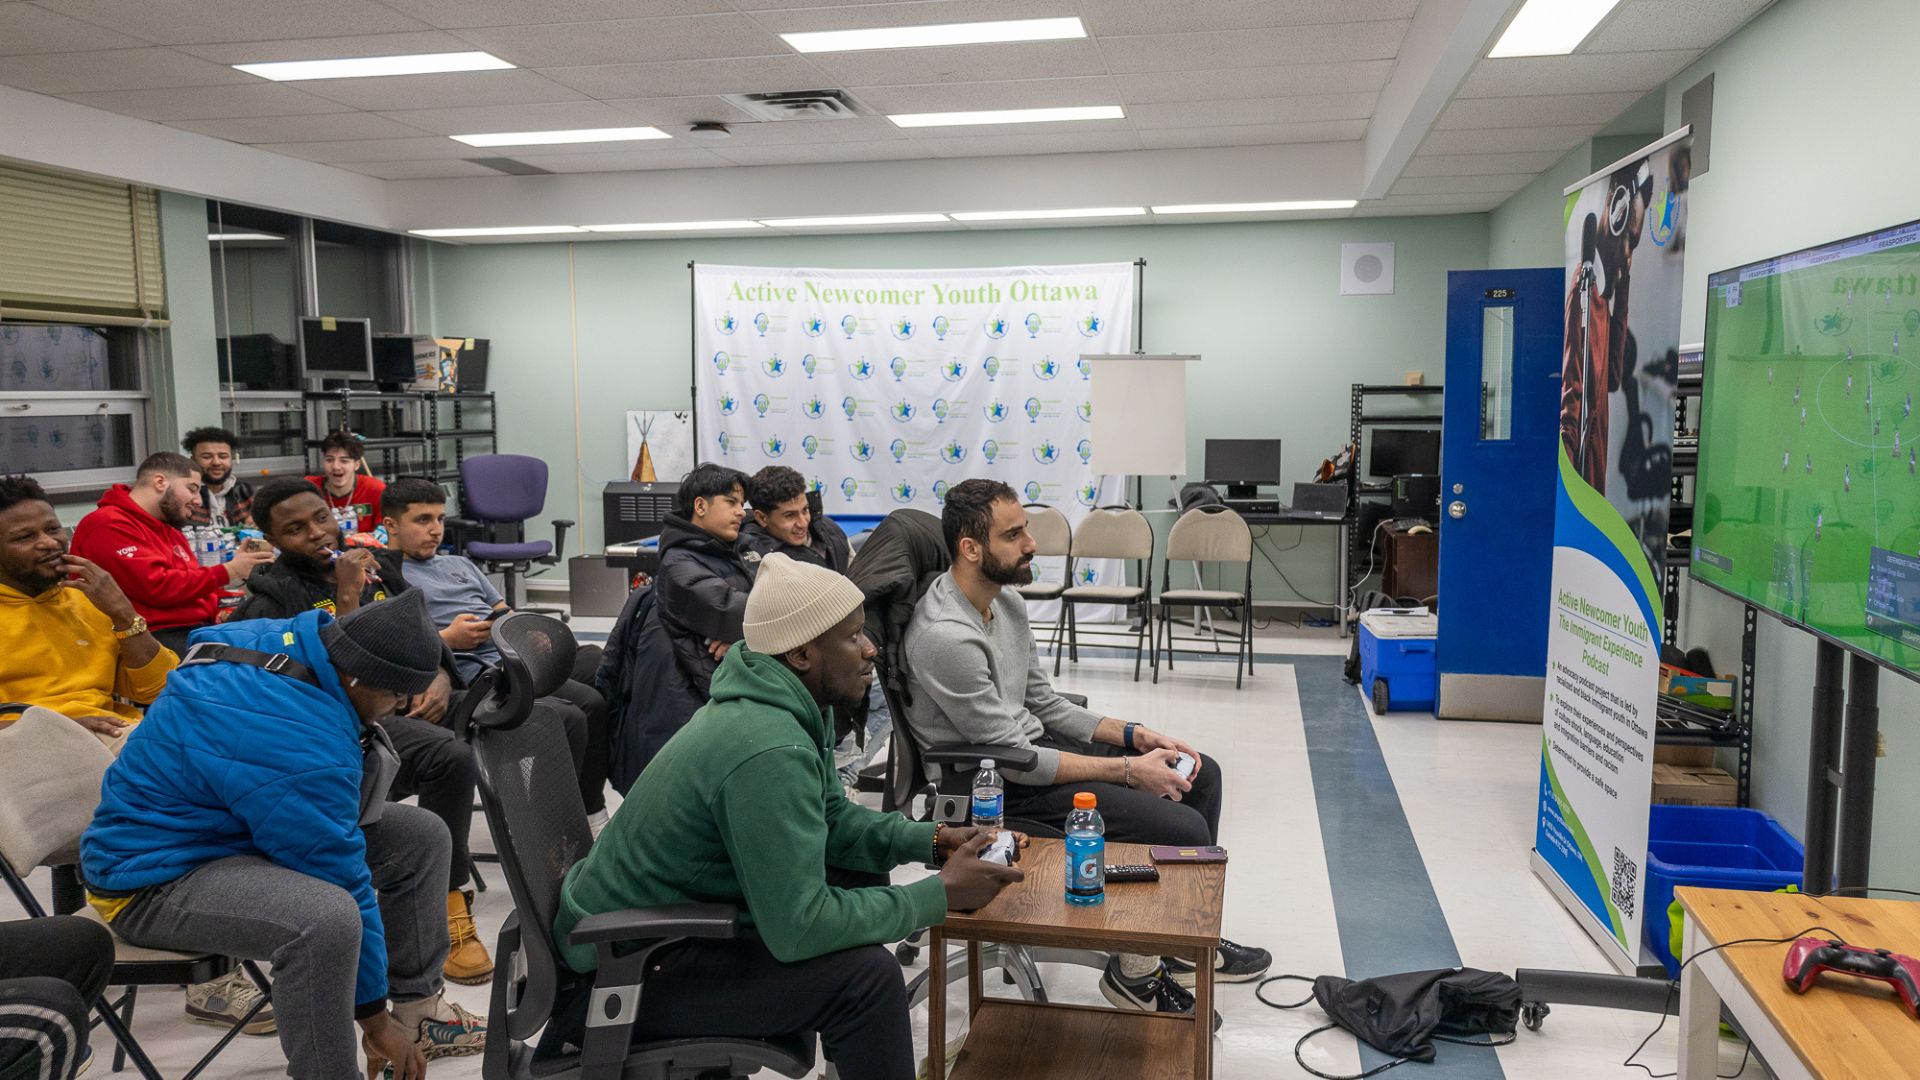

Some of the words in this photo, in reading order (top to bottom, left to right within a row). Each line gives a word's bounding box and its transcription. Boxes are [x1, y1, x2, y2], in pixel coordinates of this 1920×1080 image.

[728, 280, 797, 302] Active
[804, 281, 926, 305] Newcomer
[932, 282, 1000, 305] Youth
[1010, 280, 1098, 302] Ottawa
[1493, 289, 1507, 298] 225
[1558, 588, 1578, 610] Active
[1580, 597, 1621, 630] Newcomer
[1624, 614, 1648, 642] Youth
[1560, 614, 1569, 631] The
[1570, 621, 1602, 648] Immigrant
[1603, 634, 1644, 668] Experience
[1582, 650, 1610, 676] Podcast
[1557, 661, 1562, 671] An
[1563, 666, 1579, 682] advocacy
[1579, 676, 1595, 691] podcast
[1595, 684, 1610, 700] project
[1610, 692, 1619, 705] that
[1620, 700, 1624, 708] is
[1632, 704, 1638, 718] by
[1580, 688, 1592, 702] black
[1592, 696, 1612, 716] immigrant
[1613, 708, 1626, 724] youth
[1626, 714, 1630, 727] in
[1631, 720, 1648, 739] Ottawa
[1580, 741, 1595, 758] barriers
[1595, 752, 1603, 764] and
[1604, 758, 1618, 775] racism
[1582, 714, 1606, 736] experiences
[1606, 730, 1615, 742] and
[1616, 736, 1644, 762] perspectives
[1602, 743, 1624, 764] education
[1553, 740, 1572, 764] Determined
[1576, 762, 1591, 779] provide
[1595, 776, 1604, 790] safe
[1604, 783, 1618, 800] space
[1080, 858, 1096, 879] G
